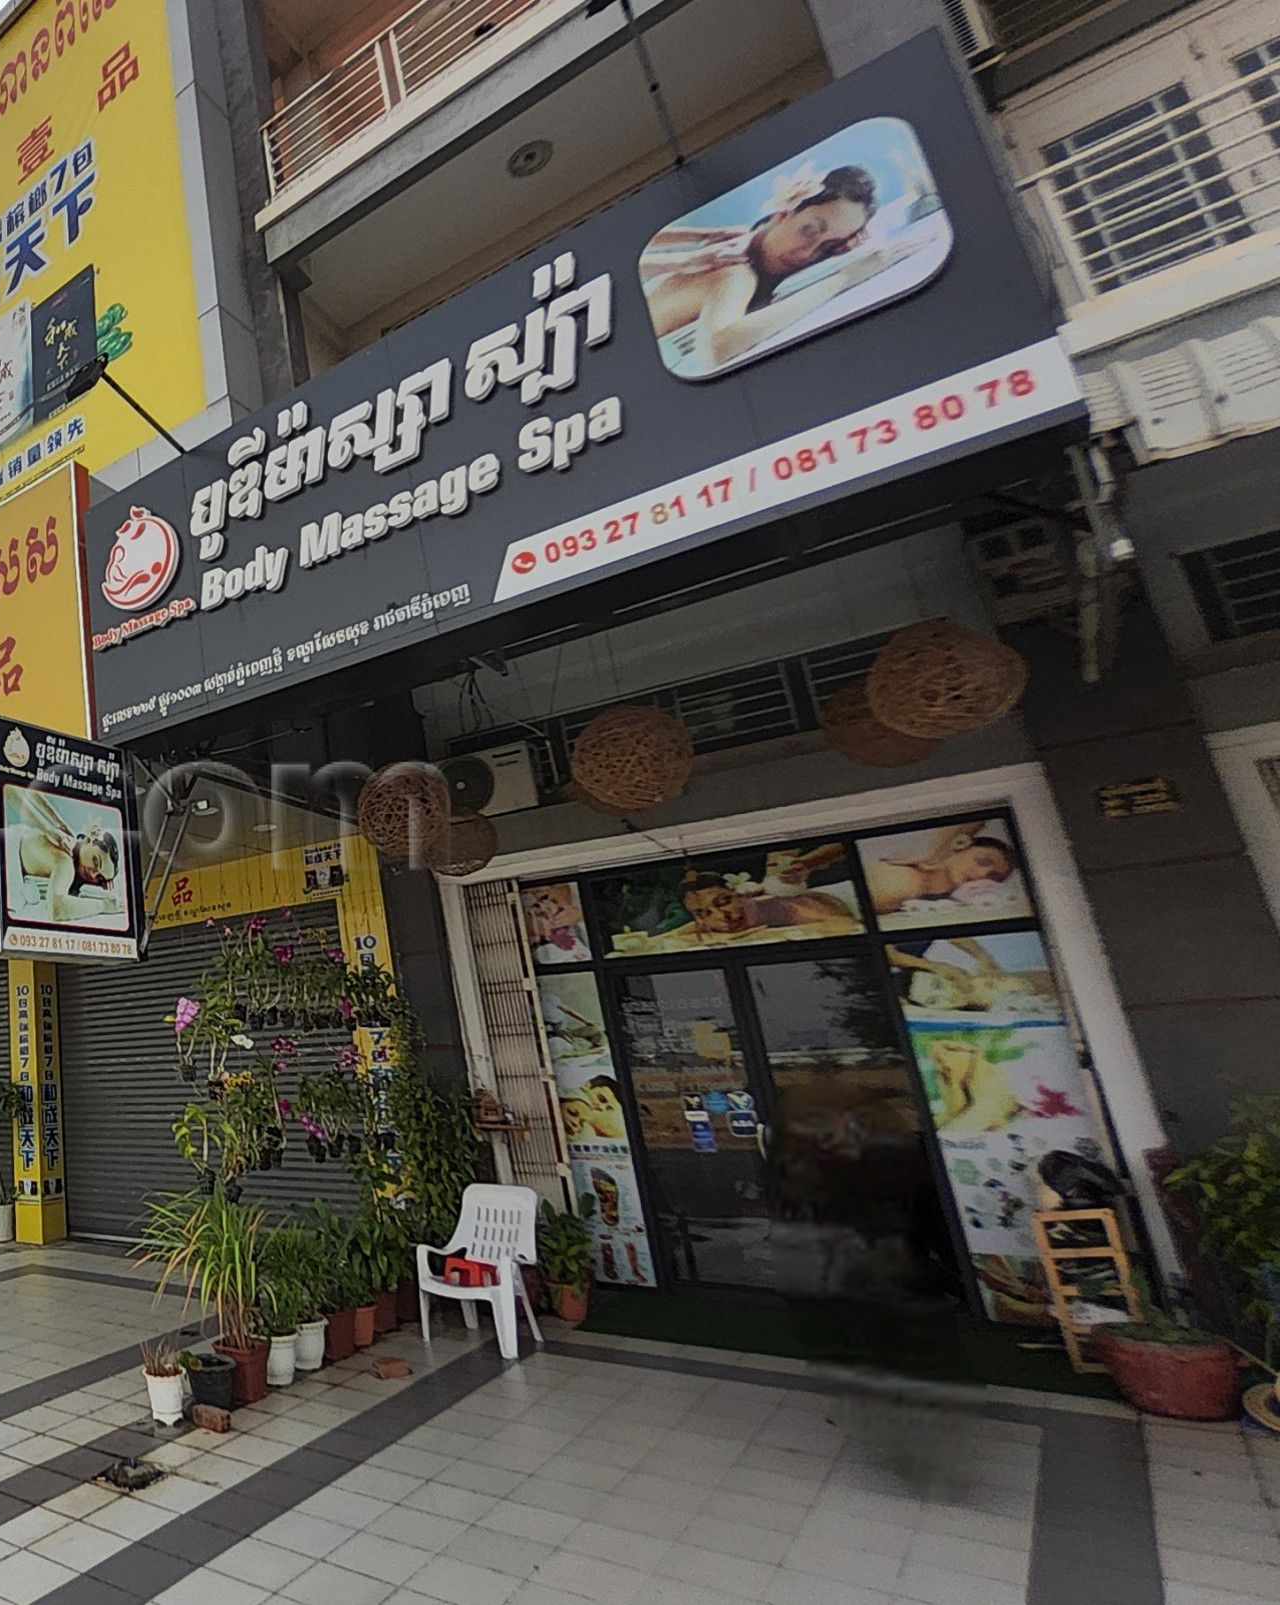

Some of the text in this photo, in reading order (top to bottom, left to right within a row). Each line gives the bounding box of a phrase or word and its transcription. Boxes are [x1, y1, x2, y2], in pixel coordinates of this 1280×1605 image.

[544, 528, 597, 564] 093
[604, 511, 640, 545] 27
[650, 494, 687, 526] 81
[697, 477, 733, 510] 17
[772, 440, 840, 482] 081
[848, 418, 900, 456] 73
[913, 392, 966, 433] 80
[976, 367, 1038, 410] 78
[200, 396, 621, 609] Body Massage Spa
[170, 597, 194, 616] Spa
[36, 767, 60, 787] Body
[63, 773, 103, 797] Massage
[105, 784, 122, 800] Spa
[171, 876, 193, 907] 品
[19, 934, 36, 947] 093
[39, 936, 49, 948] 27
[52, 938, 62, 949] 81
[65, 939, 75, 951] 17
[81, 940, 97, 952] 081
[98, 942, 109, 953] 73
[121, 943, 133, 955] 78
